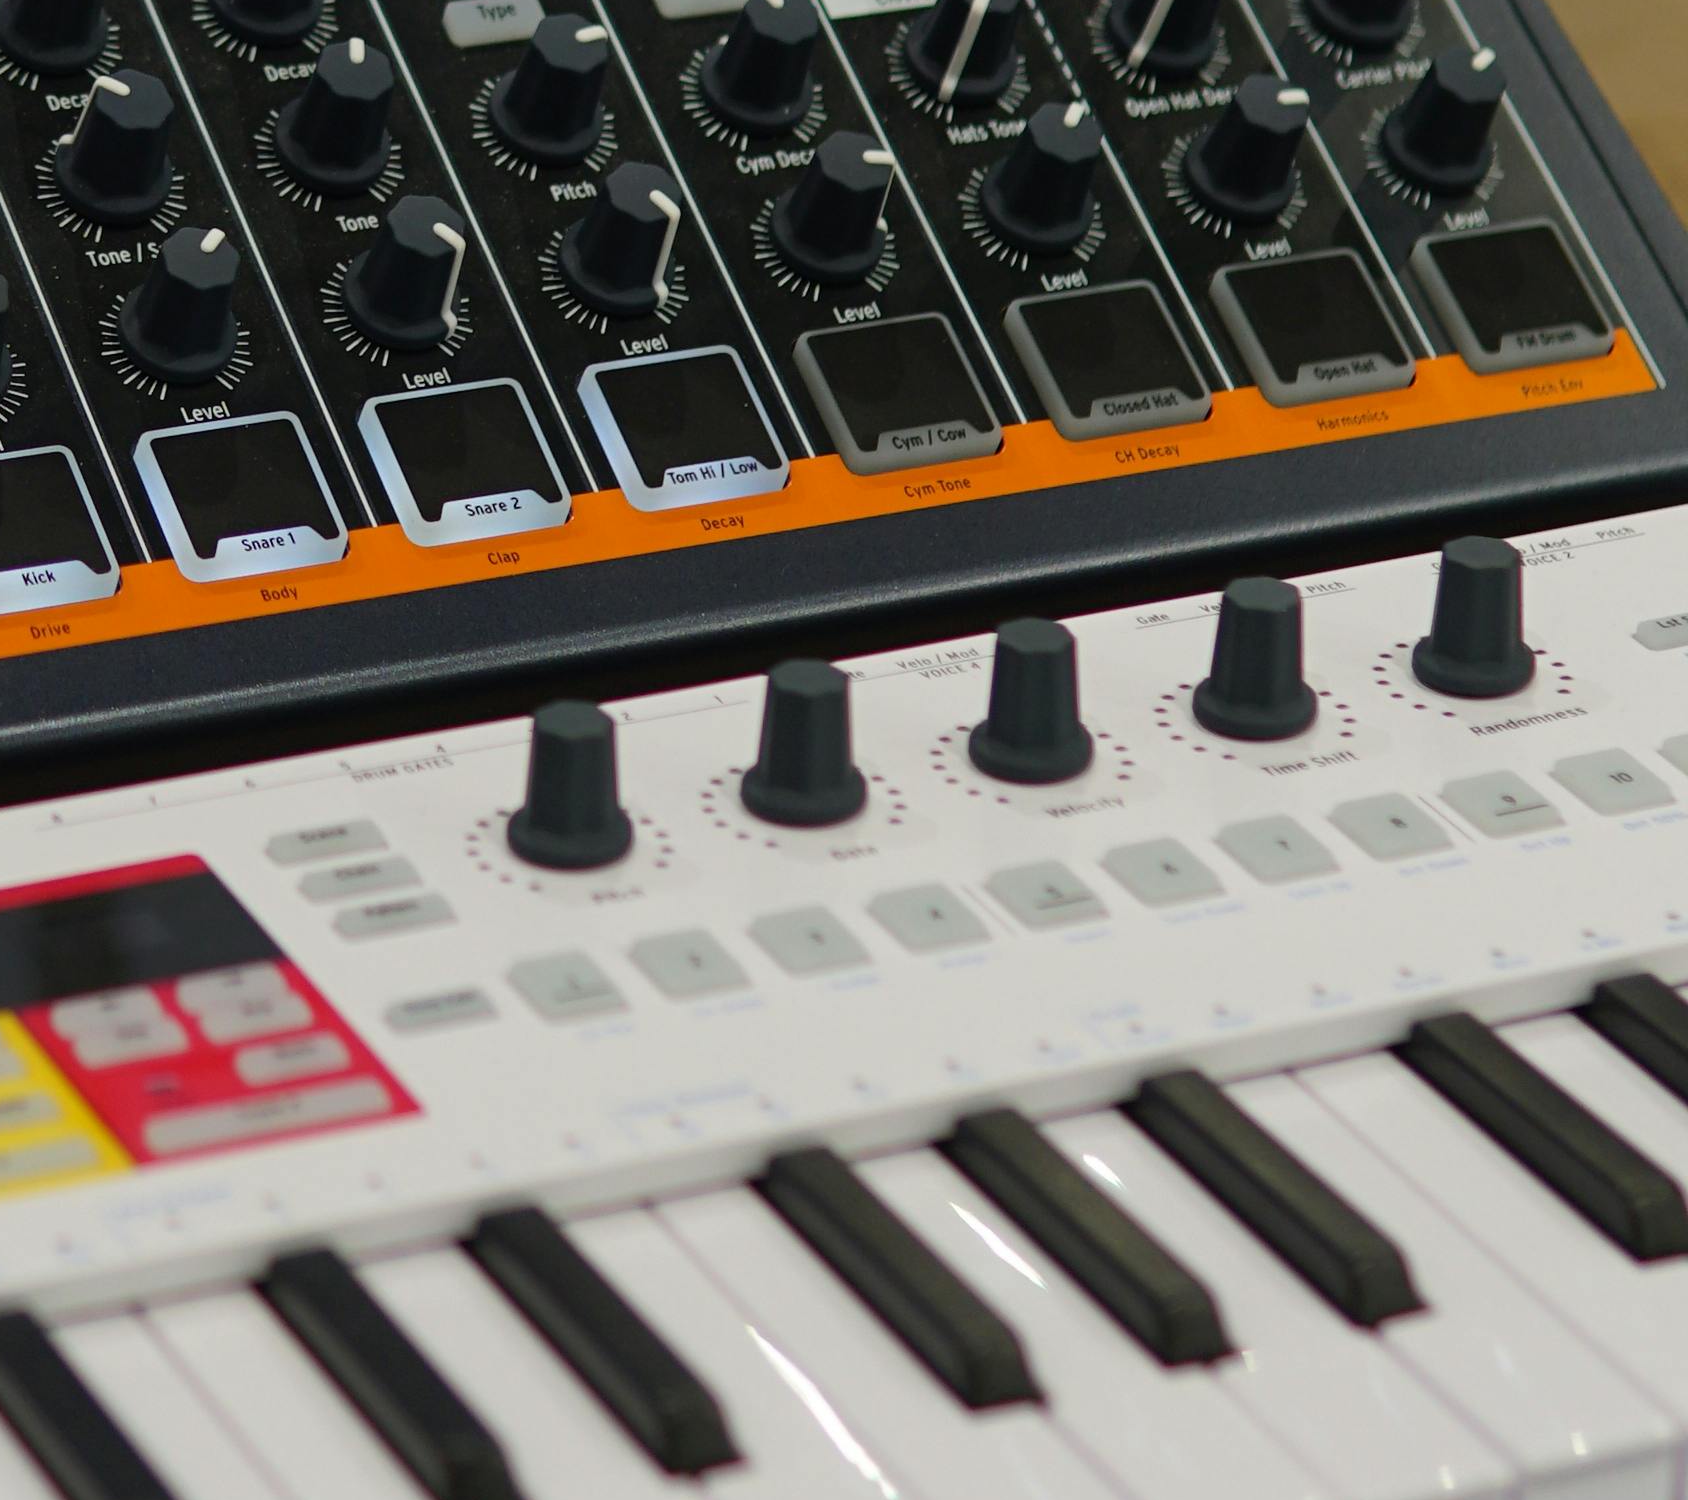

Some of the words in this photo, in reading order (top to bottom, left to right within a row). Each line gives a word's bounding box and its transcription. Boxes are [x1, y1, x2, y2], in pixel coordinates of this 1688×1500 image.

[476, 3, 517, 21] Type
[46, 93, 90, 112] Deca
[736, 153, 776, 176] Cym
[776, 149, 816, 169] Dec
[550, 181, 597, 202] Pitch
[335, 214, 379, 234] Tone
[86, 250, 132, 268] Tone
[1040, 268, 1089, 292] Level
[833, 300, 881, 324] Level
[620, 333, 669, 356] Level
[402, 366, 452, 390] Level
[180, 401, 231, 424] Level
[1103, 396, 1150, 417] Closed
[1154, 392, 1179, 408] Hat
[1316, 409, 1389, 431] Harmonics
[892, 433, 924, 450] Cym
[937, 428, 967, 442] Cow
[1115, 448, 1136, 464] CH
[1138, 443, 1181, 461] Decay
[667, 472, 698, 485] Tom
[700, 466, 716, 480] Hi
[729, 461, 758, 475] Low
[903, 483, 936, 499] Cym
[937, 476, 972, 492] Tone
[465, 500, 507, 517] Snare
[511, 497, 522, 510] 2
[701, 514, 745, 531] Decay
[241, 534, 286, 552] Snare
[289, 532, 297, 545] 1
[487, 551, 520, 566] Clap
[22, 570, 56, 586] Kick
[1306, 578, 1346, 595] Pitch
[261, 586, 298, 602] Body
[1136, 611, 1171, 626] Gate
[30, 623, 71, 639] Drive
[1469, 704, 1589, 738] Randomness
[1262, 758, 1308, 777] Time
[1311, 749, 1360, 771] Shift
[1609, 771, 1635, 785] 10
